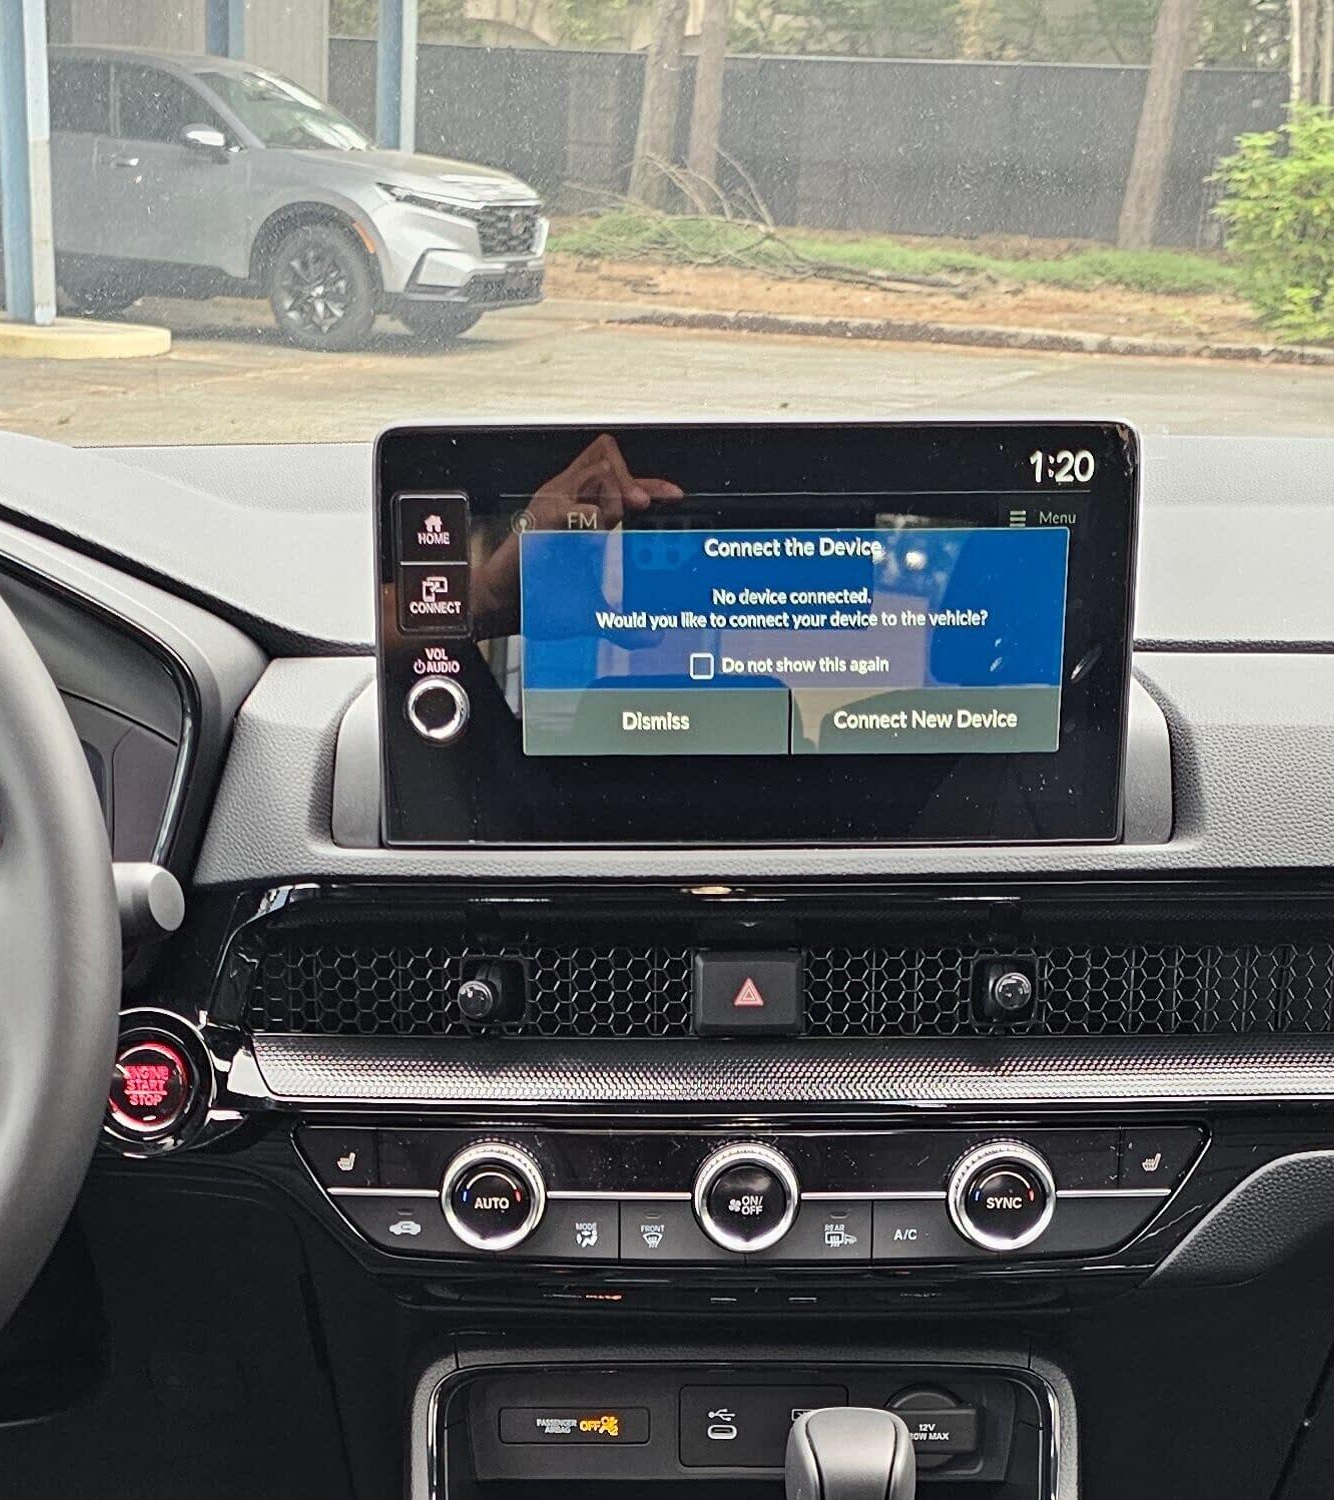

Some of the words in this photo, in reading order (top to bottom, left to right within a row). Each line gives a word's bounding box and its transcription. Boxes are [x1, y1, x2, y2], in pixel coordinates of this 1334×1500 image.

[1029, 449, 1095, 483] 1:20
[566, 511, 599, 530] FM
[1038, 511, 1077, 524] Menu
[417, 531, 451, 545] HOME
[703, 537, 781, 558] Connect
[784, 537, 815, 557] the
[819, 536, 883, 556] Device
[712, 588, 737, 605] No
[738, 587, 788, 605] device
[789, 587, 872, 604] connected.
[408, 601, 462, 614] CONNECT
[595, 611, 647, 629] Would
[649, 614, 678, 631] you
[680, 611, 707, 628] like
[709, 612, 726, 628] to
[728, 612, 790, 628] connect
[791, 613, 828, 630] your
[829, 610, 878, 627] device
[880, 611, 898, 627] to
[901, 610, 927, 626] the
[929, 609, 989, 626] vehicle?
[424, 648, 448, 660] VOL
[426, 660, 461, 673] AUDIO
[721, 657, 744, 673] Do
[747, 657, 773, 673] not
[775, 657, 816, 672] show
[818, 656, 847, 672] this
[849, 656, 890, 674] again
[622, 711, 690, 730] Dismiss
[833, 710, 907, 729] Connect
[911, 710, 953, 729] New
[956, 709, 1018, 728] Device
[126, 1080, 166, 1091] START
[129, 1094, 163, 1106] STOP
[474, 1196, 510, 1209] AUTO
[741, 1195, 764, 1206] ON/
[986, 1196, 1023, 1209] SYNC
[741, 1205, 763, 1215] OFF
[575, 1222, 597, 1231] MODE
[640, 1224, 665, 1233] FRONT
[824, 1224, 845, 1232] REAR
[894, 1228, 918, 1241] A/C
[579, 1420, 601, 1432] OFF
[918, 1423, 936, 1432] 12V
[928, 1432, 950, 1441] MAX
